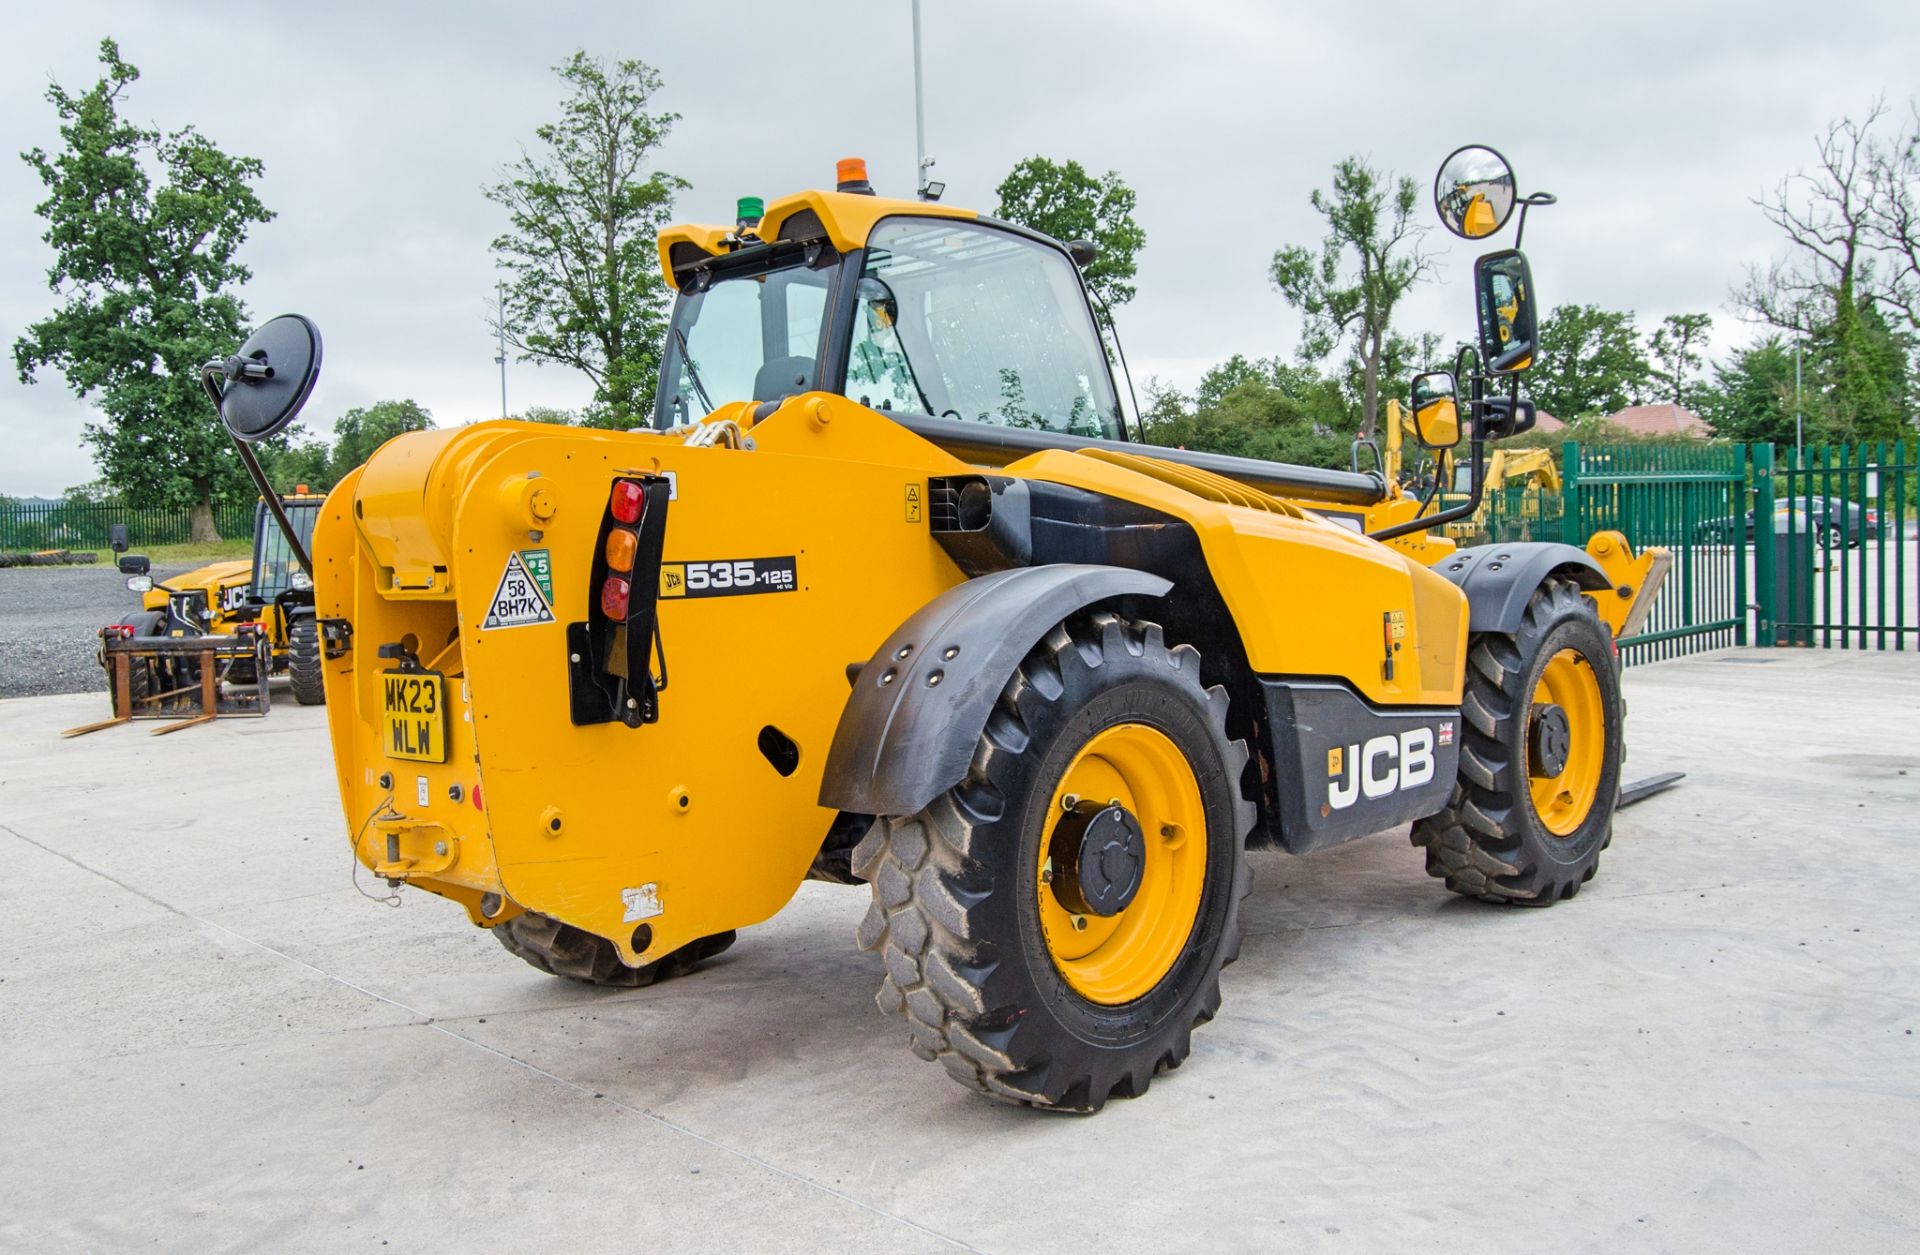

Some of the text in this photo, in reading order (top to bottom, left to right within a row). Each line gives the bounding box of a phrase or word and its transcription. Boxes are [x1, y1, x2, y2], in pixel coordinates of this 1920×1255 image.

[538, 559, 547, 573] 5
[687, 561, 792, 589] 535-125
[508, 580, 526, 597] 58
[664, 573, 681, 588] JCB
[498, 597, 537, 617] BH7K
[385, 678, 435, 713] MK23
[392, 718, 430, 755] WLW
[1328, 727, 1435, 810] JCB
